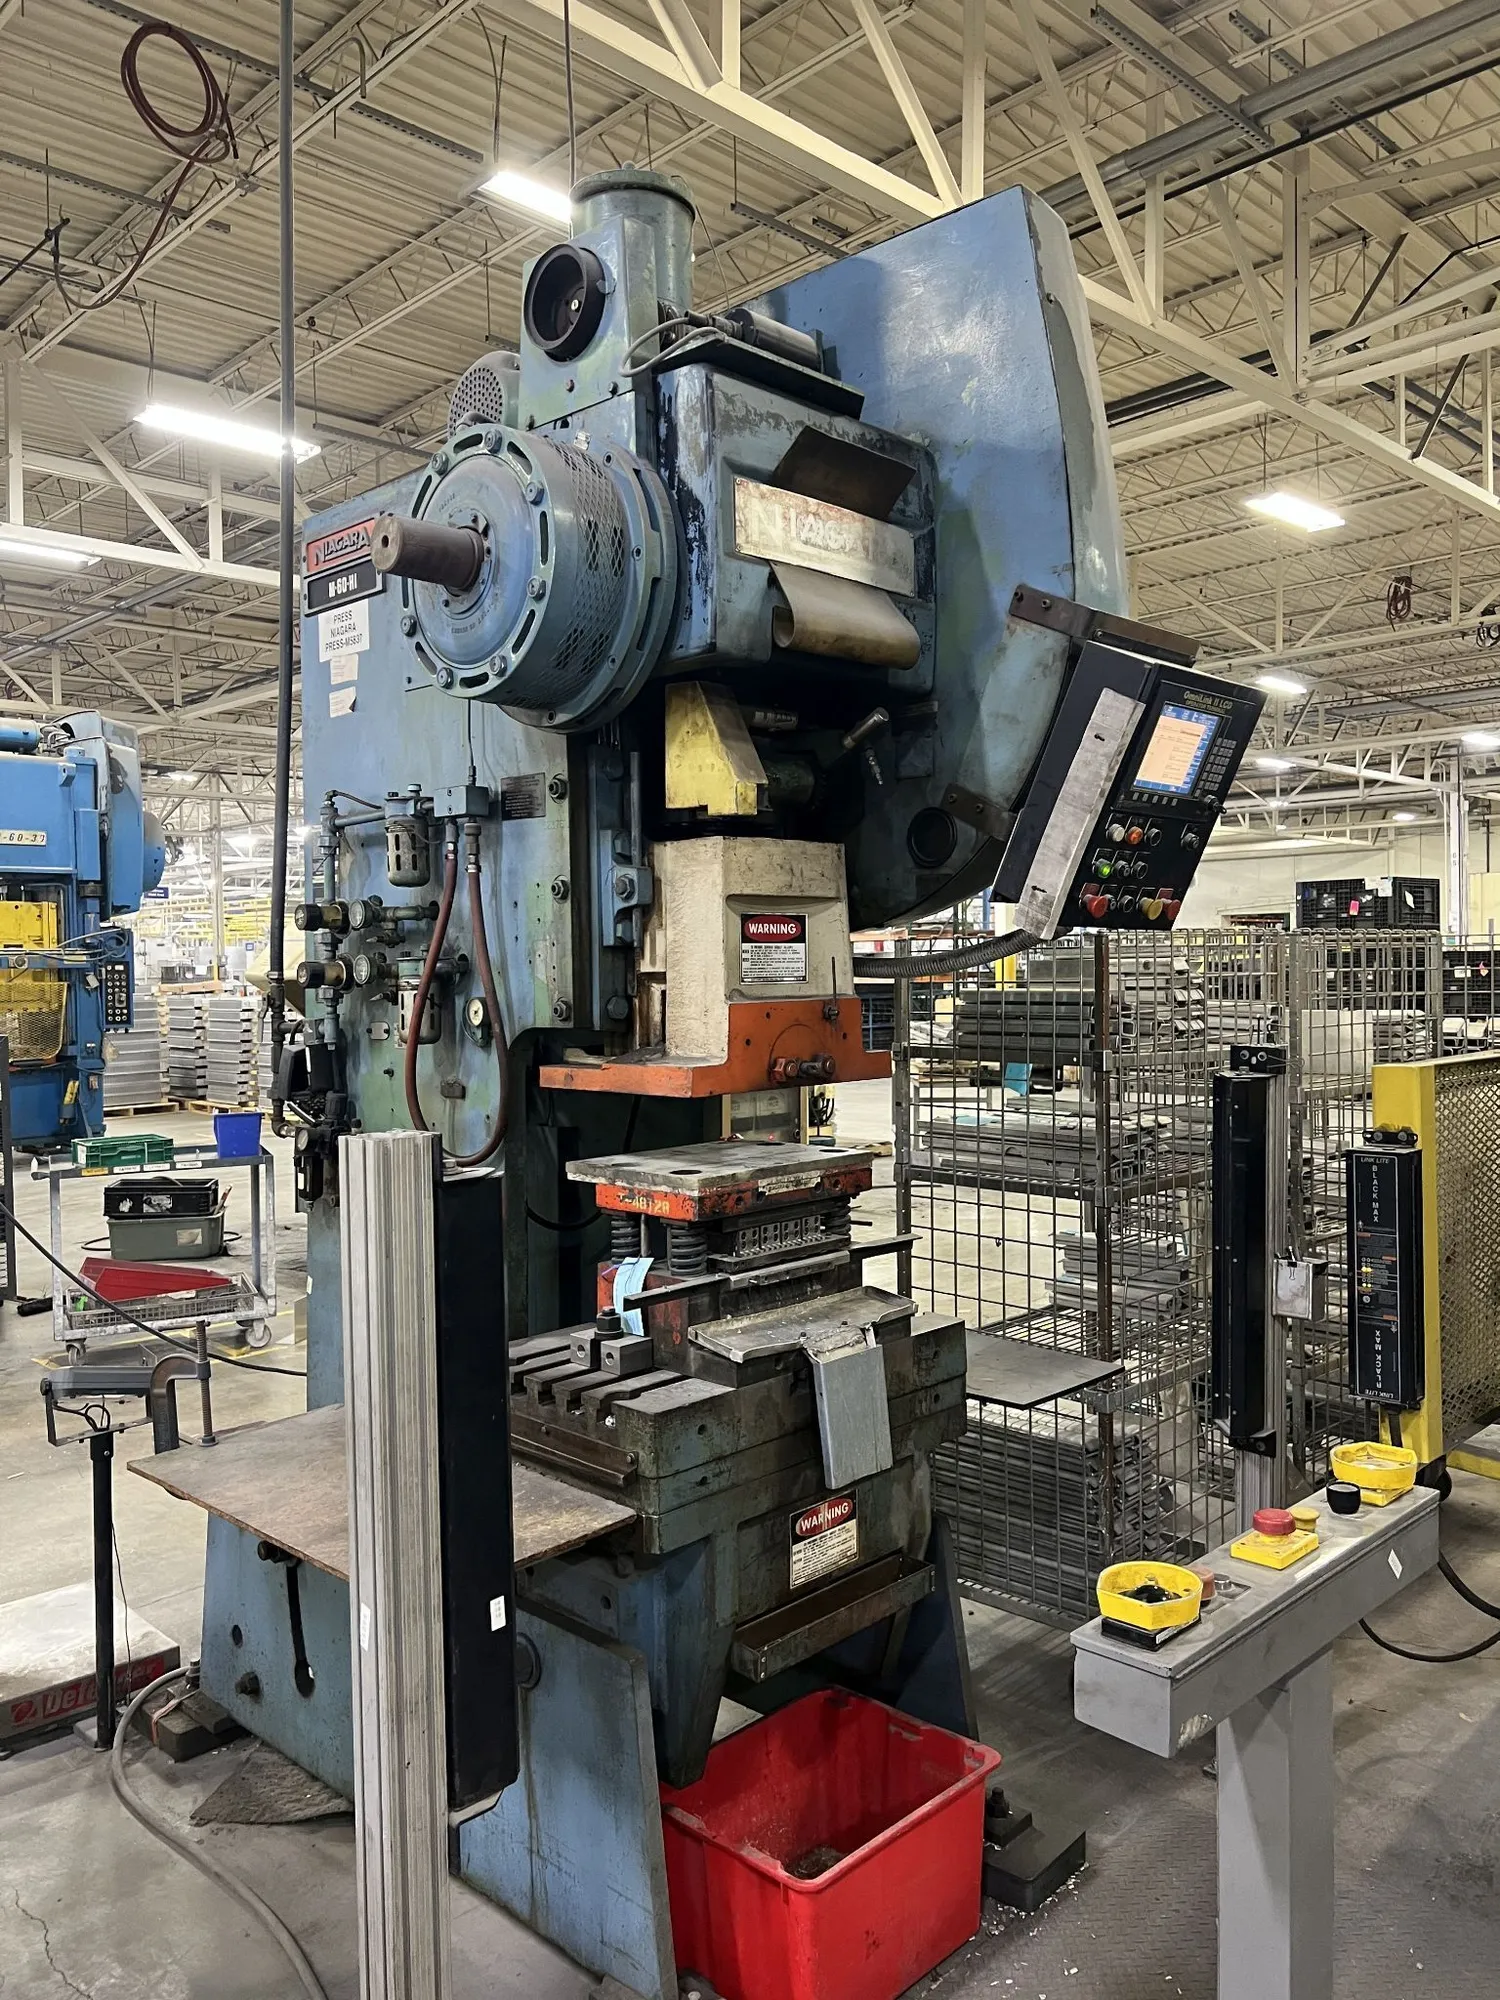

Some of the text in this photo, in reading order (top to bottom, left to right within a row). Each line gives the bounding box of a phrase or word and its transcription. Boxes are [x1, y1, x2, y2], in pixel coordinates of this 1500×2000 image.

[314, 526, 371, 566] NIAGARA
[333, 610, 353, 624] PRESS
[330, 622, 357, 638] NIAGARA
[748, 923, 797, 935] WARNING
[801, 1502, 849, 1532] WARNING
